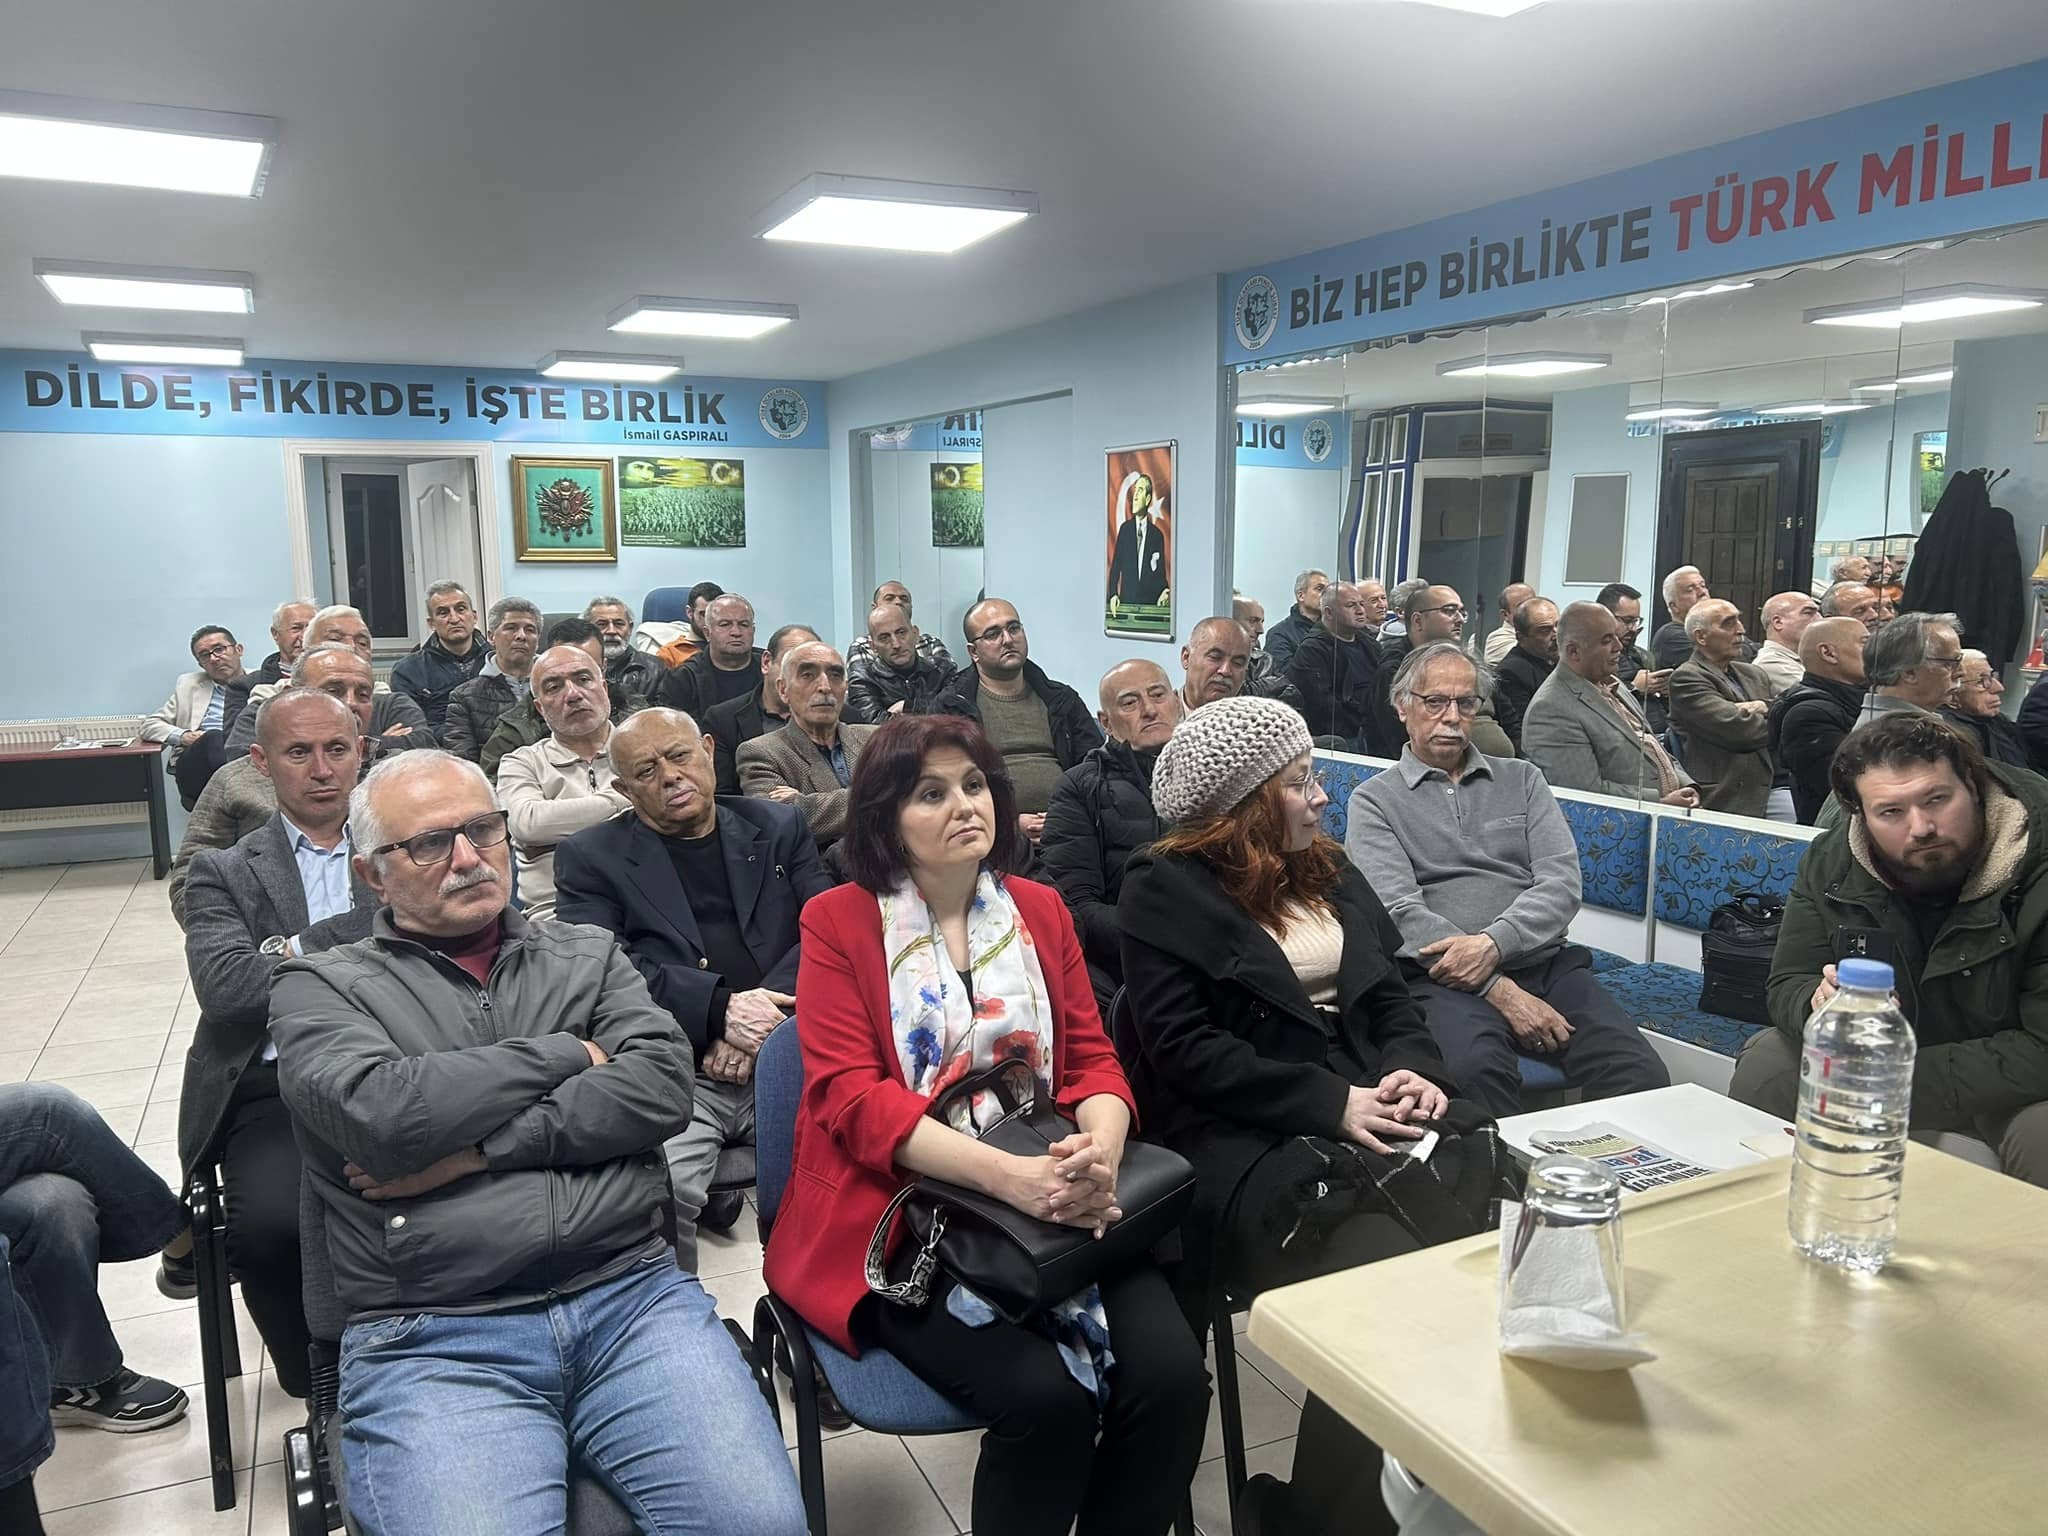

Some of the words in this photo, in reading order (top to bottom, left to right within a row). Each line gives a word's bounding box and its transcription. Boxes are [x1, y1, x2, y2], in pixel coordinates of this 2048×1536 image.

[1290, 274, 1344, 330] BİZ
[1354, 261, 1427, 317] HEP
[1440, 206, 1652, 300] BİRLİKTE
[1669, 161, 1839, 252] TÜRK
[24, 363, 212, 418] DİLDE,
[227, 370, 450, 425] FİKİRDE,
[466, 377, 567, 425] İŞTE
[581, 383, 727, 425] BİRLİK
[623, 426, 660, 440] İsmail
[663, 430, 728, 442] GASPIRALI
